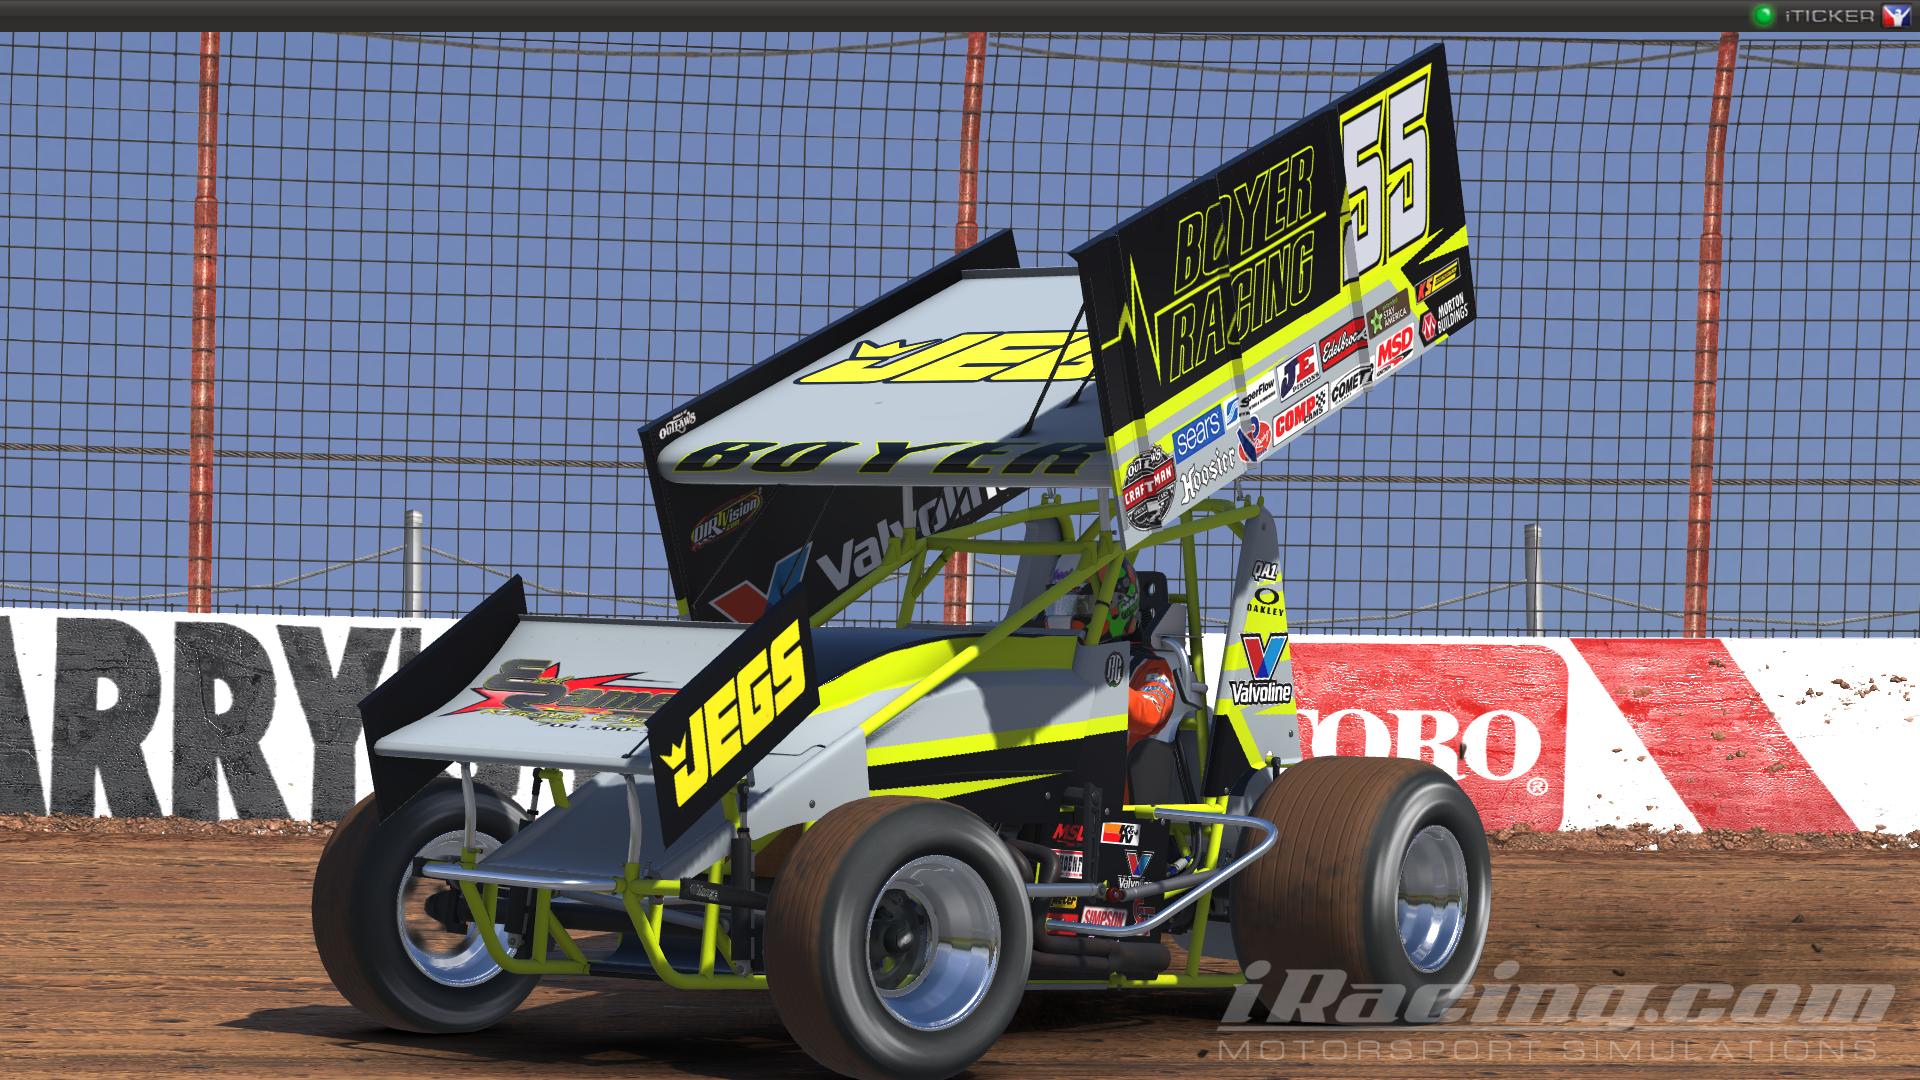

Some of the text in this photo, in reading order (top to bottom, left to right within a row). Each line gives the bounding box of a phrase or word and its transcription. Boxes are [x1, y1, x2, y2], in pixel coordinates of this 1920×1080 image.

[1341, 75, 1430, 286] 55
[1173, 145, 1315, 295] BOYER
[1169, 230, 1315, 383] RACING
[1437, 303, 1469, 334] BUILDINGS
[1438, 291, 1465, 319] MORTON
[1377, 326, 1414, 368] MSD
[1280, 347, 1316, 399] JE
[1177, 411, 1221, 456] sears
[1275, 395, 1316, 438] COMP
[1303, 405, 1324, 425] CAMS
[673, 440, 1108, 474] BOYER
[1124, 464, 1173, 506] CRAFTMAN
[1247, 603, 1285, 617] OAKLEY
[675, 618, 807, 808] JEGS
[1229, 681, 1292, 705] Valvoline
